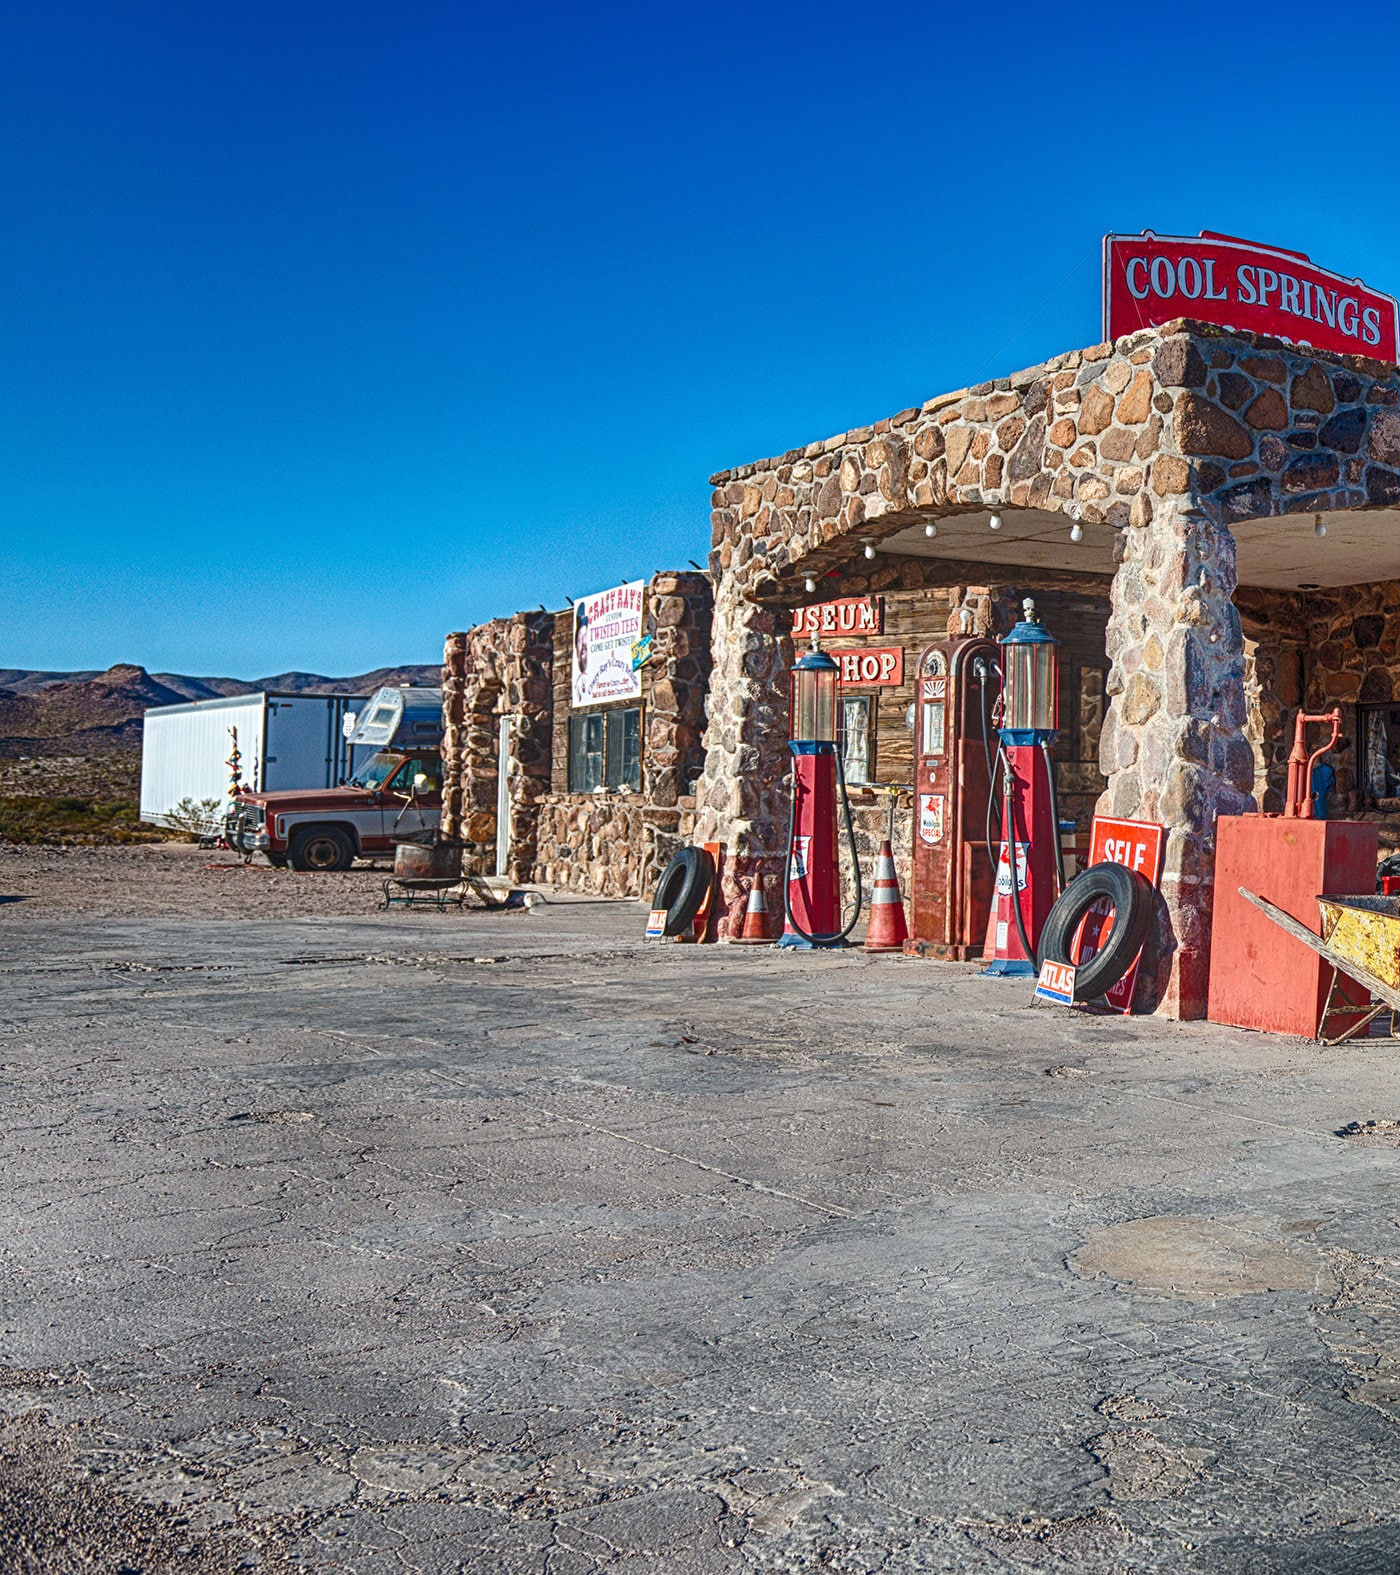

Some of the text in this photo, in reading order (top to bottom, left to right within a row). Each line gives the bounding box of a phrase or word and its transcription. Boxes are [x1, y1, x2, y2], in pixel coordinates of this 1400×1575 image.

[1126, 256, 1382, 346] COOL SPRINGS
[588, 589, 642, 625] CRAZY RAY'S
[789, 604, 875, 632] USEUM
[590, 617, 639, 642] TWISTED TEES
[922, 828, 941, 837] SPECIAL
[1103, 838, 1147, 871] SELF
[1038, 964, 1074, 992] ATLAS
